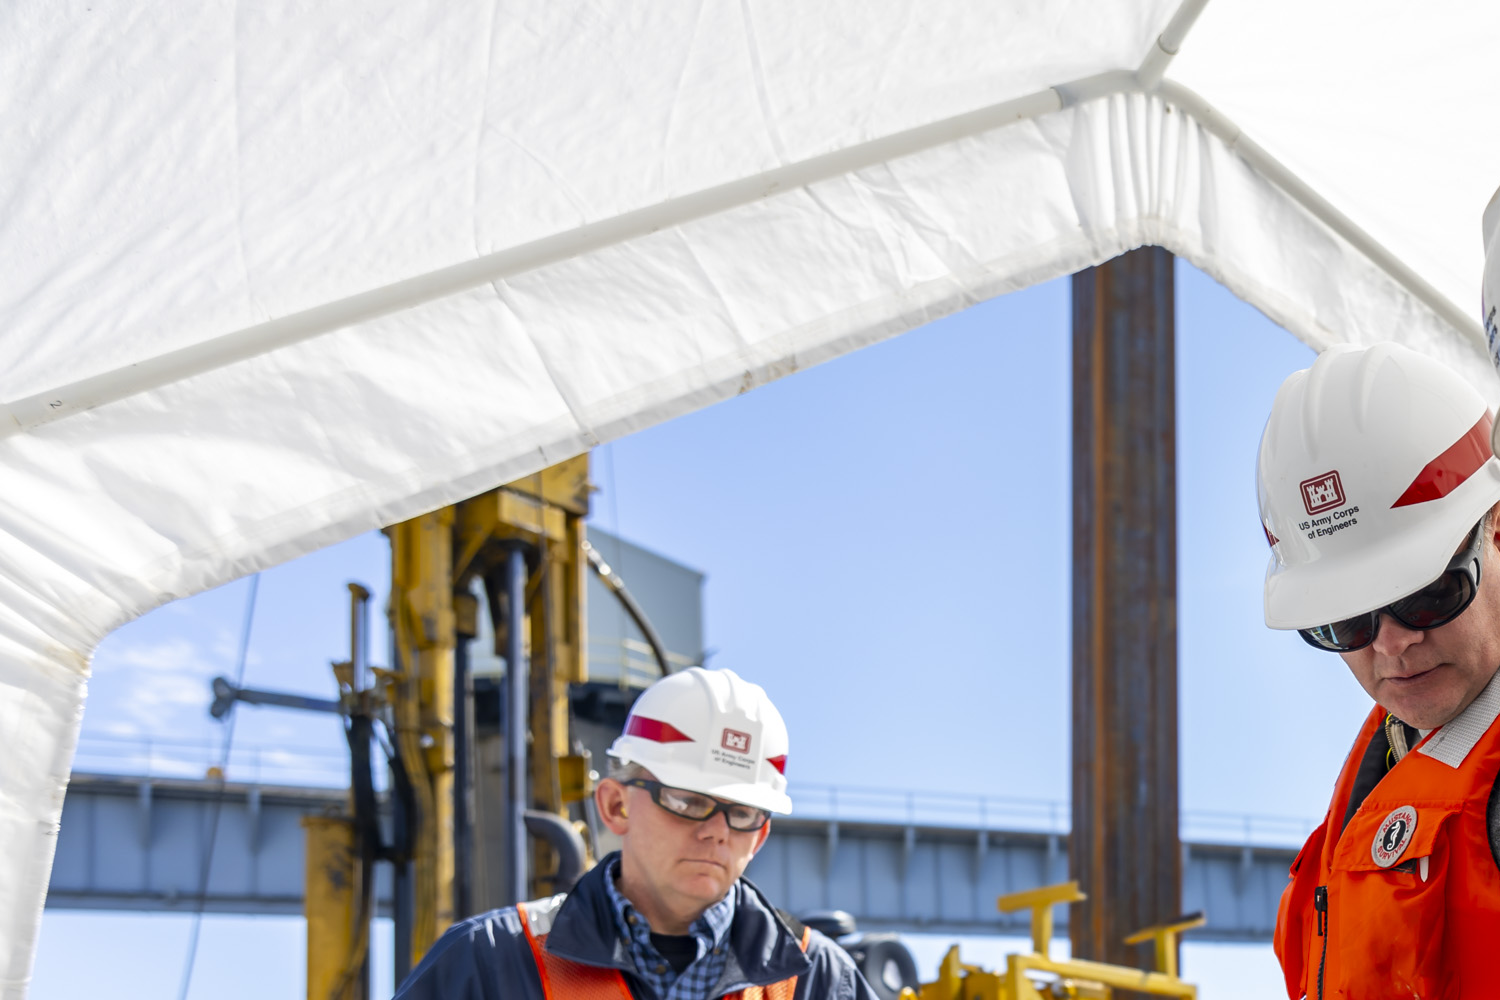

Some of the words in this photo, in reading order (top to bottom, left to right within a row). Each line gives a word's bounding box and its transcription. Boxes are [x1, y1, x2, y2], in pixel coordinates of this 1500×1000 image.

[1298, 521, 1311, 531] US
[1311, 515, 1332, 528] Army
[1333, 505, 1360, 521] Corps
[1307, 530, 1316, 540] of
[1316, 517, 1358, 537] Engineers
[1377, 837, 1408, 860] SURVIVAL
